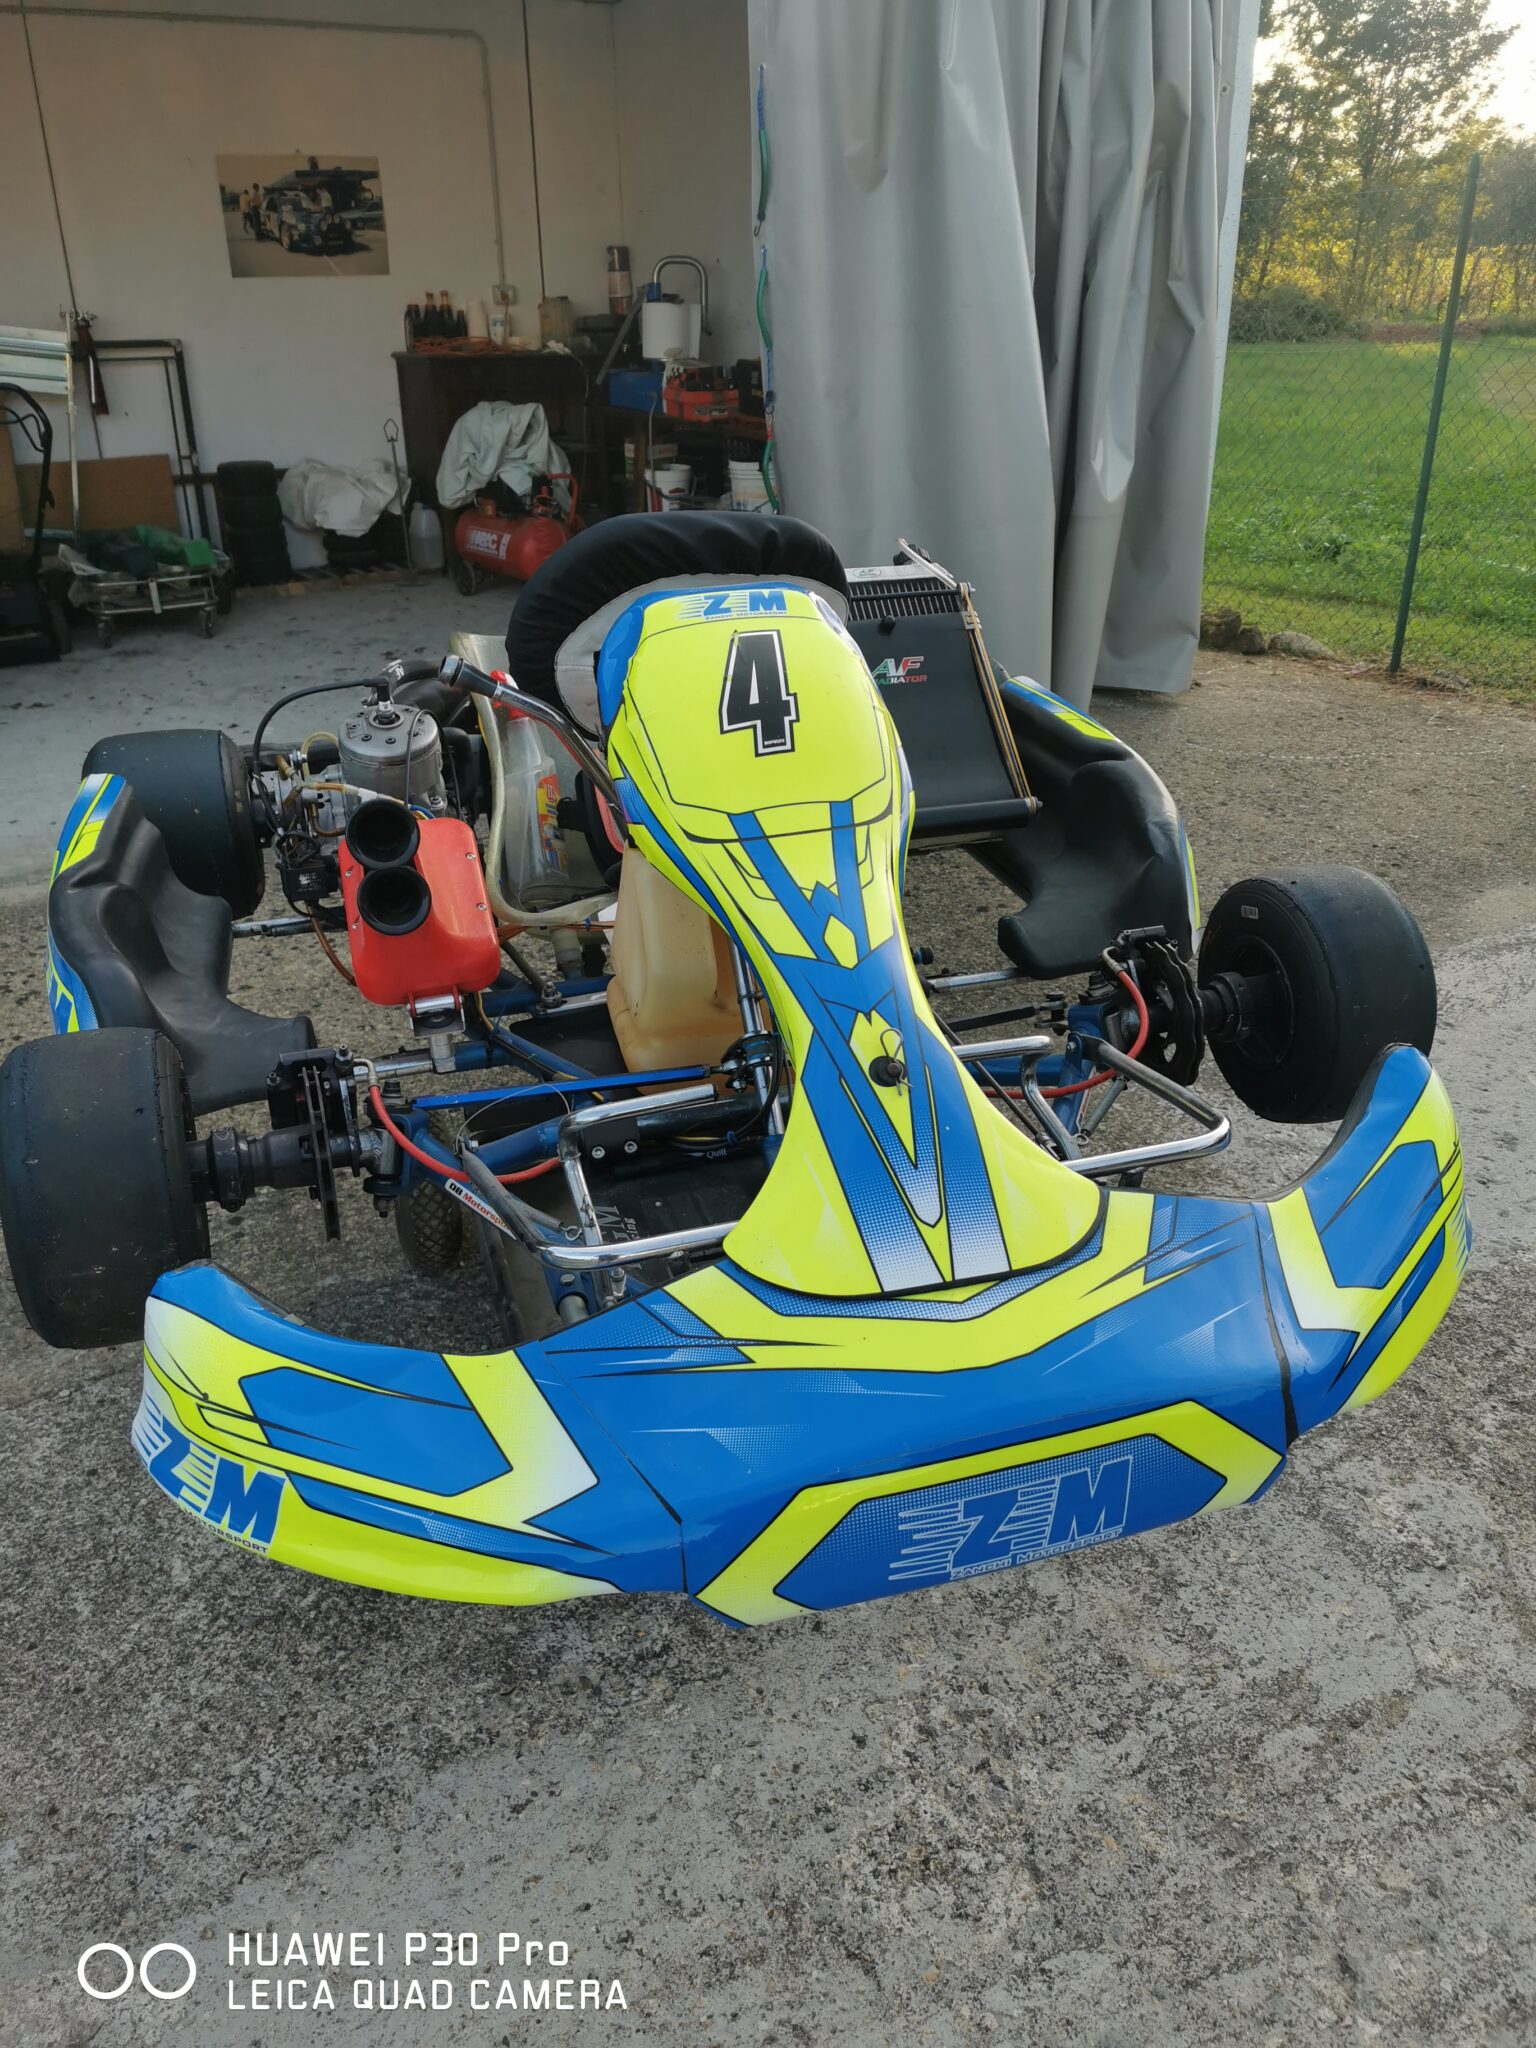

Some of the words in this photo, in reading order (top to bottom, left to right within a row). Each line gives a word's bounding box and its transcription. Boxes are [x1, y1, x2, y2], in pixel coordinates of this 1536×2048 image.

[719, 629, 800, 757] 4
[872, 656, 924, 678] AF
[449, 1181, 464, 1197] DB
[463, 1191, 509, 1231] Motorspo
[150, 1414, 286, 1544] ZM
[949, 1454, 1133, 1571] ZM
[950, 1556, 1012, 1580] ZANCHI
[1016, 1527, 1123, 1565] MOTORSPORT
